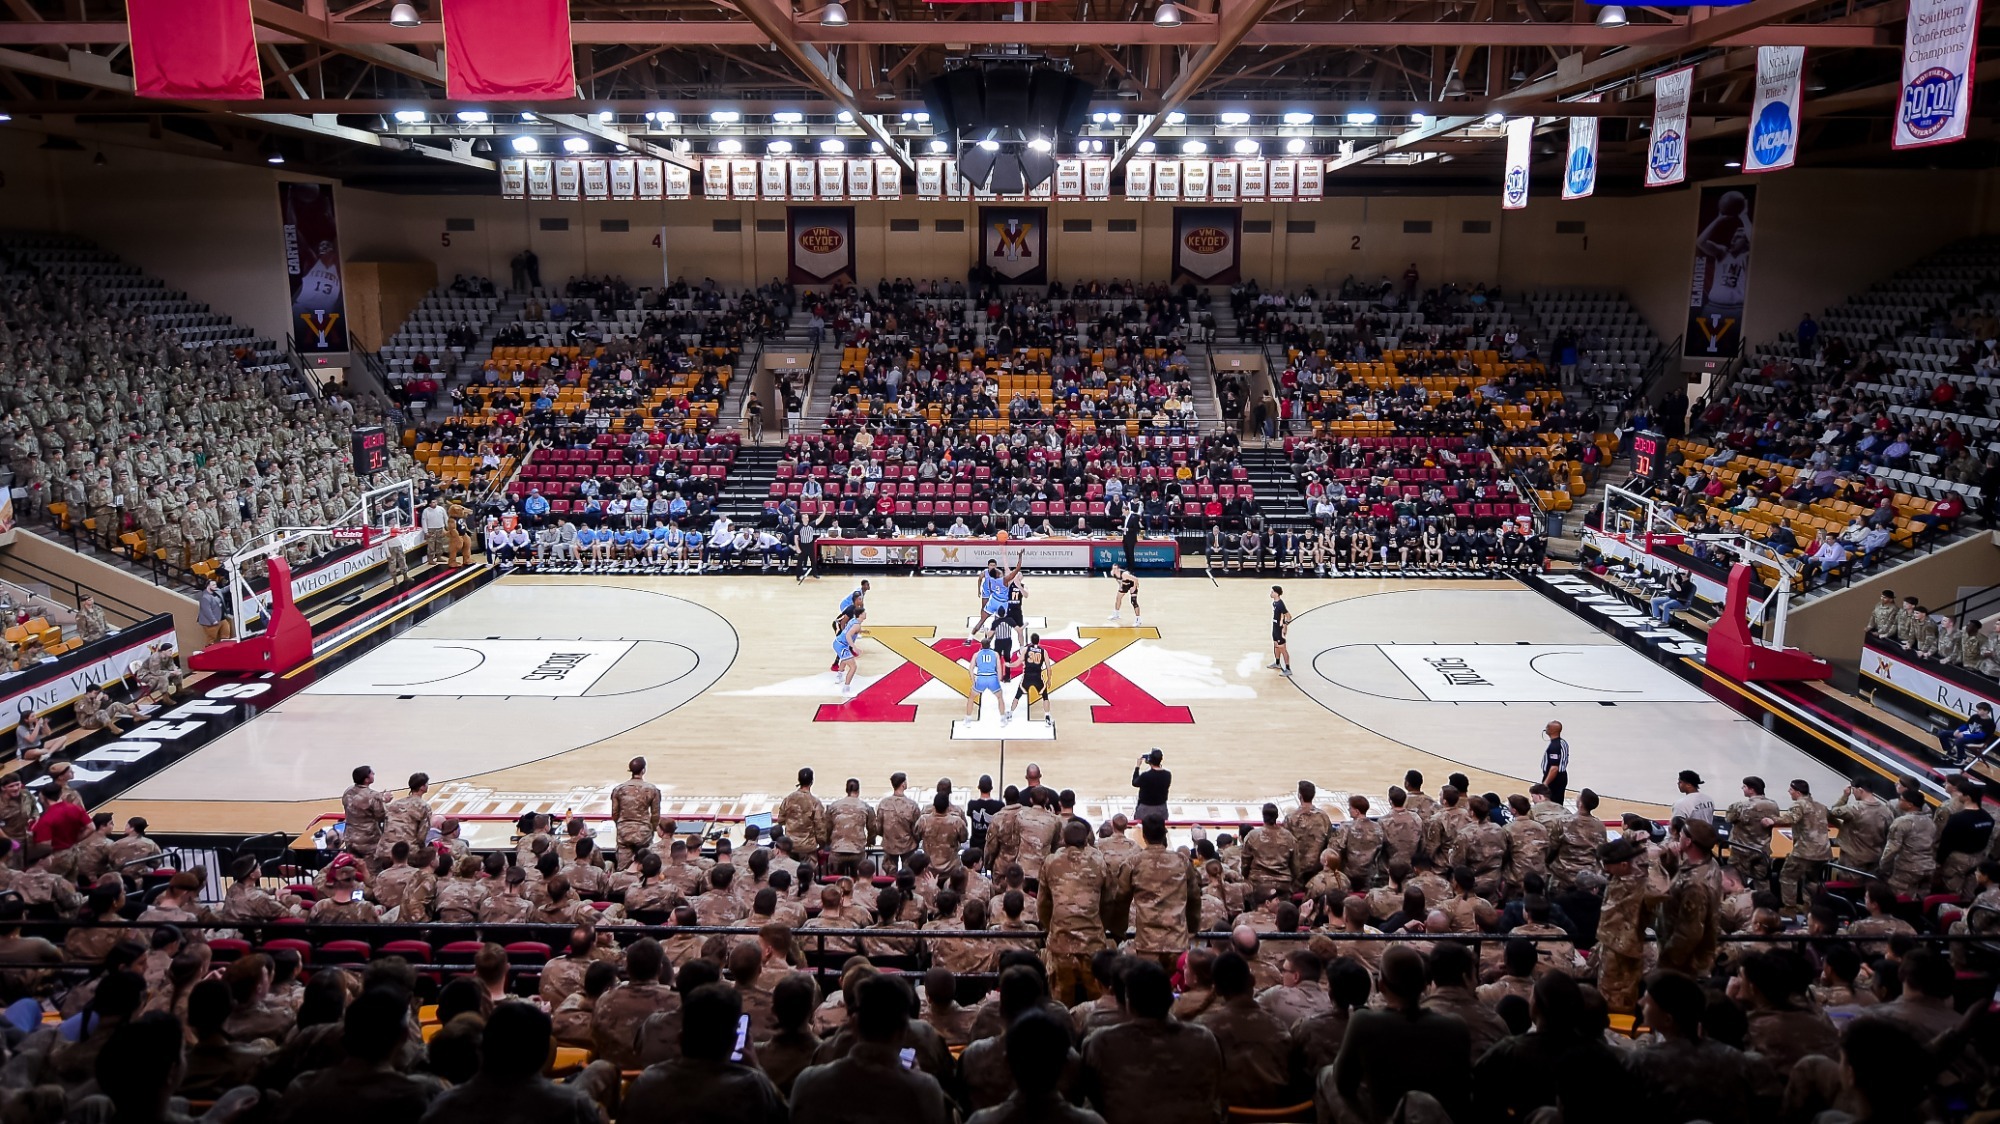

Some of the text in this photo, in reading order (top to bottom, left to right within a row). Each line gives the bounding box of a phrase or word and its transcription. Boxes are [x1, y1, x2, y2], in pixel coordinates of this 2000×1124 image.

[1918, 6, 1964, 27] Southern
[1912, 23, 1967, 46] Conference
[1909, 42, 1965, 63] Champions
[1765, 87, 1781, 99] Elite
[1904, 74, 1963, 123] SOCON
[1755, 130, 1790, 151] NCAA
[533, 181, 548, 190] 1924
[560, 182, 575, 190] 1929
[615, 181, 630, 190] 1943
[643, 181, 658, 190] 1954
[671, 180, 685, 189] 1954
[795, 182, 811, 190] 1965
[951, 182, 966, 190] 197
[1034, 182, 1049, 190] 978
[1217, 184, 1231, 192] 1992
[1274, 181, 1289, 189] 2009
[1303, 181, 1318, 189] 2009
[442, 233, 450, 247] 5
[652, 234, 661, 248] 4
[803, 236, 839, 246] KEYDET
[1188, 236, 1225, 246] KEYDET
[1351, 236, 1360, 250] 2
[1582, 236, 1588, 250] 1
[284, 225, 300, 275] CARTER
[314, 281, 333, 295] 13
[1721, 276, 1737, 288] 33
[1636, 455, 1649, 475] 30
[1630, 549, 1646, 564] THE
[296, 569, 339, 594] WHOLE
[343, 552, 375, 575] DAMN
[982, 654, 991, 663] 10
[1027, 651, 1042, 664] 30
[521, 652, 592, 681] SOCON
[1423, 657, 1494, 686] SOCON
[17, 664, 108, 714] ONE VMI
